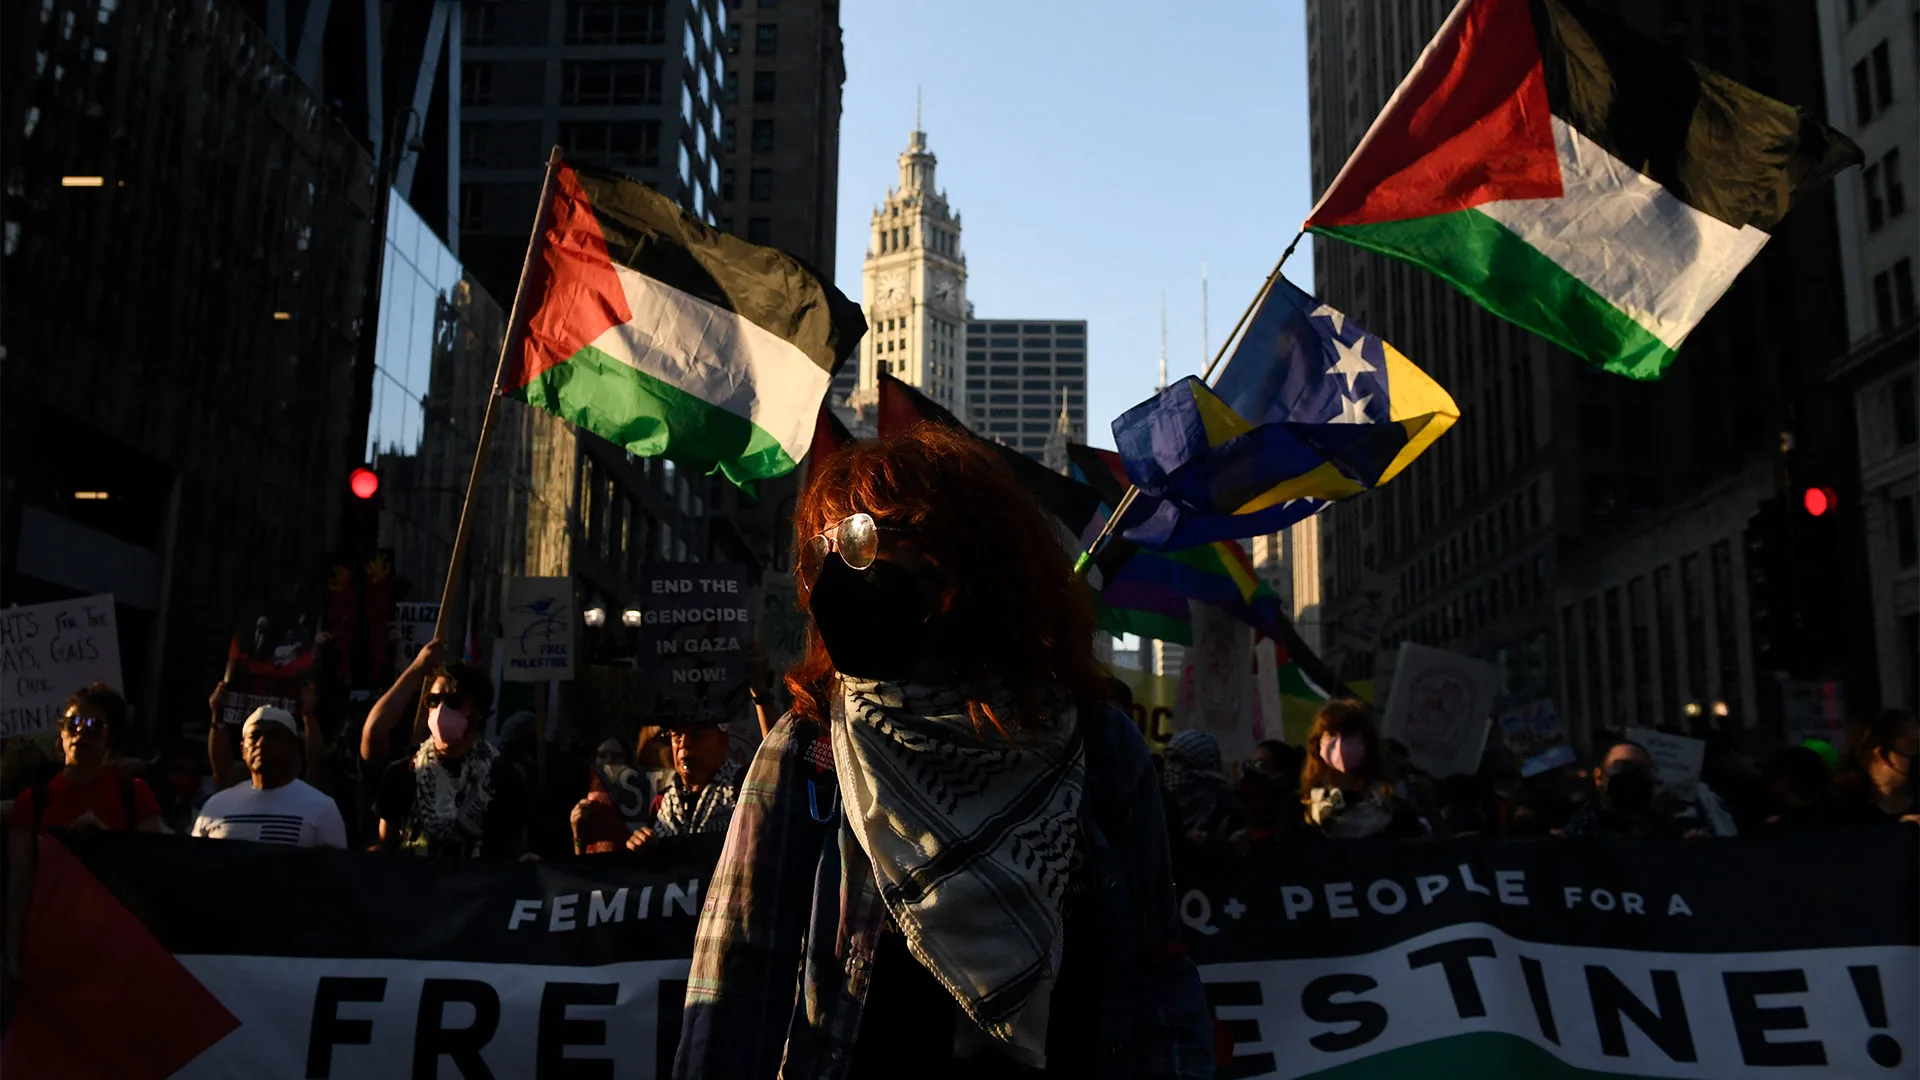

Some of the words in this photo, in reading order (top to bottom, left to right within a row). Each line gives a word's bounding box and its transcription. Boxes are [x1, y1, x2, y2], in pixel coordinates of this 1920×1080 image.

[651, 579, 693, 594] END
[700, 578, 739, 594] THE
[396, 606, 440, 622] ALIZ
[643, 607, 748, 625] GENOCIDE
[540, 644, 568, 655] FREE
[656, 640, 677, 654] IN
[682, 637, 741, 653] GAZA
[510, 657, 569, 668] PALESTINE
[671, 666, 728, 684] NOW!
[507, 878, 699, 932] FEMIN
[1279, 862, 1531, 922] PEOPLE
[1564, 885, 1648, 917] FOR
[1666, 891, 1695, 918] A
[305, 976, 688, 1080] FRE
[1202, 936, 1904, 1079] ESTINE!
